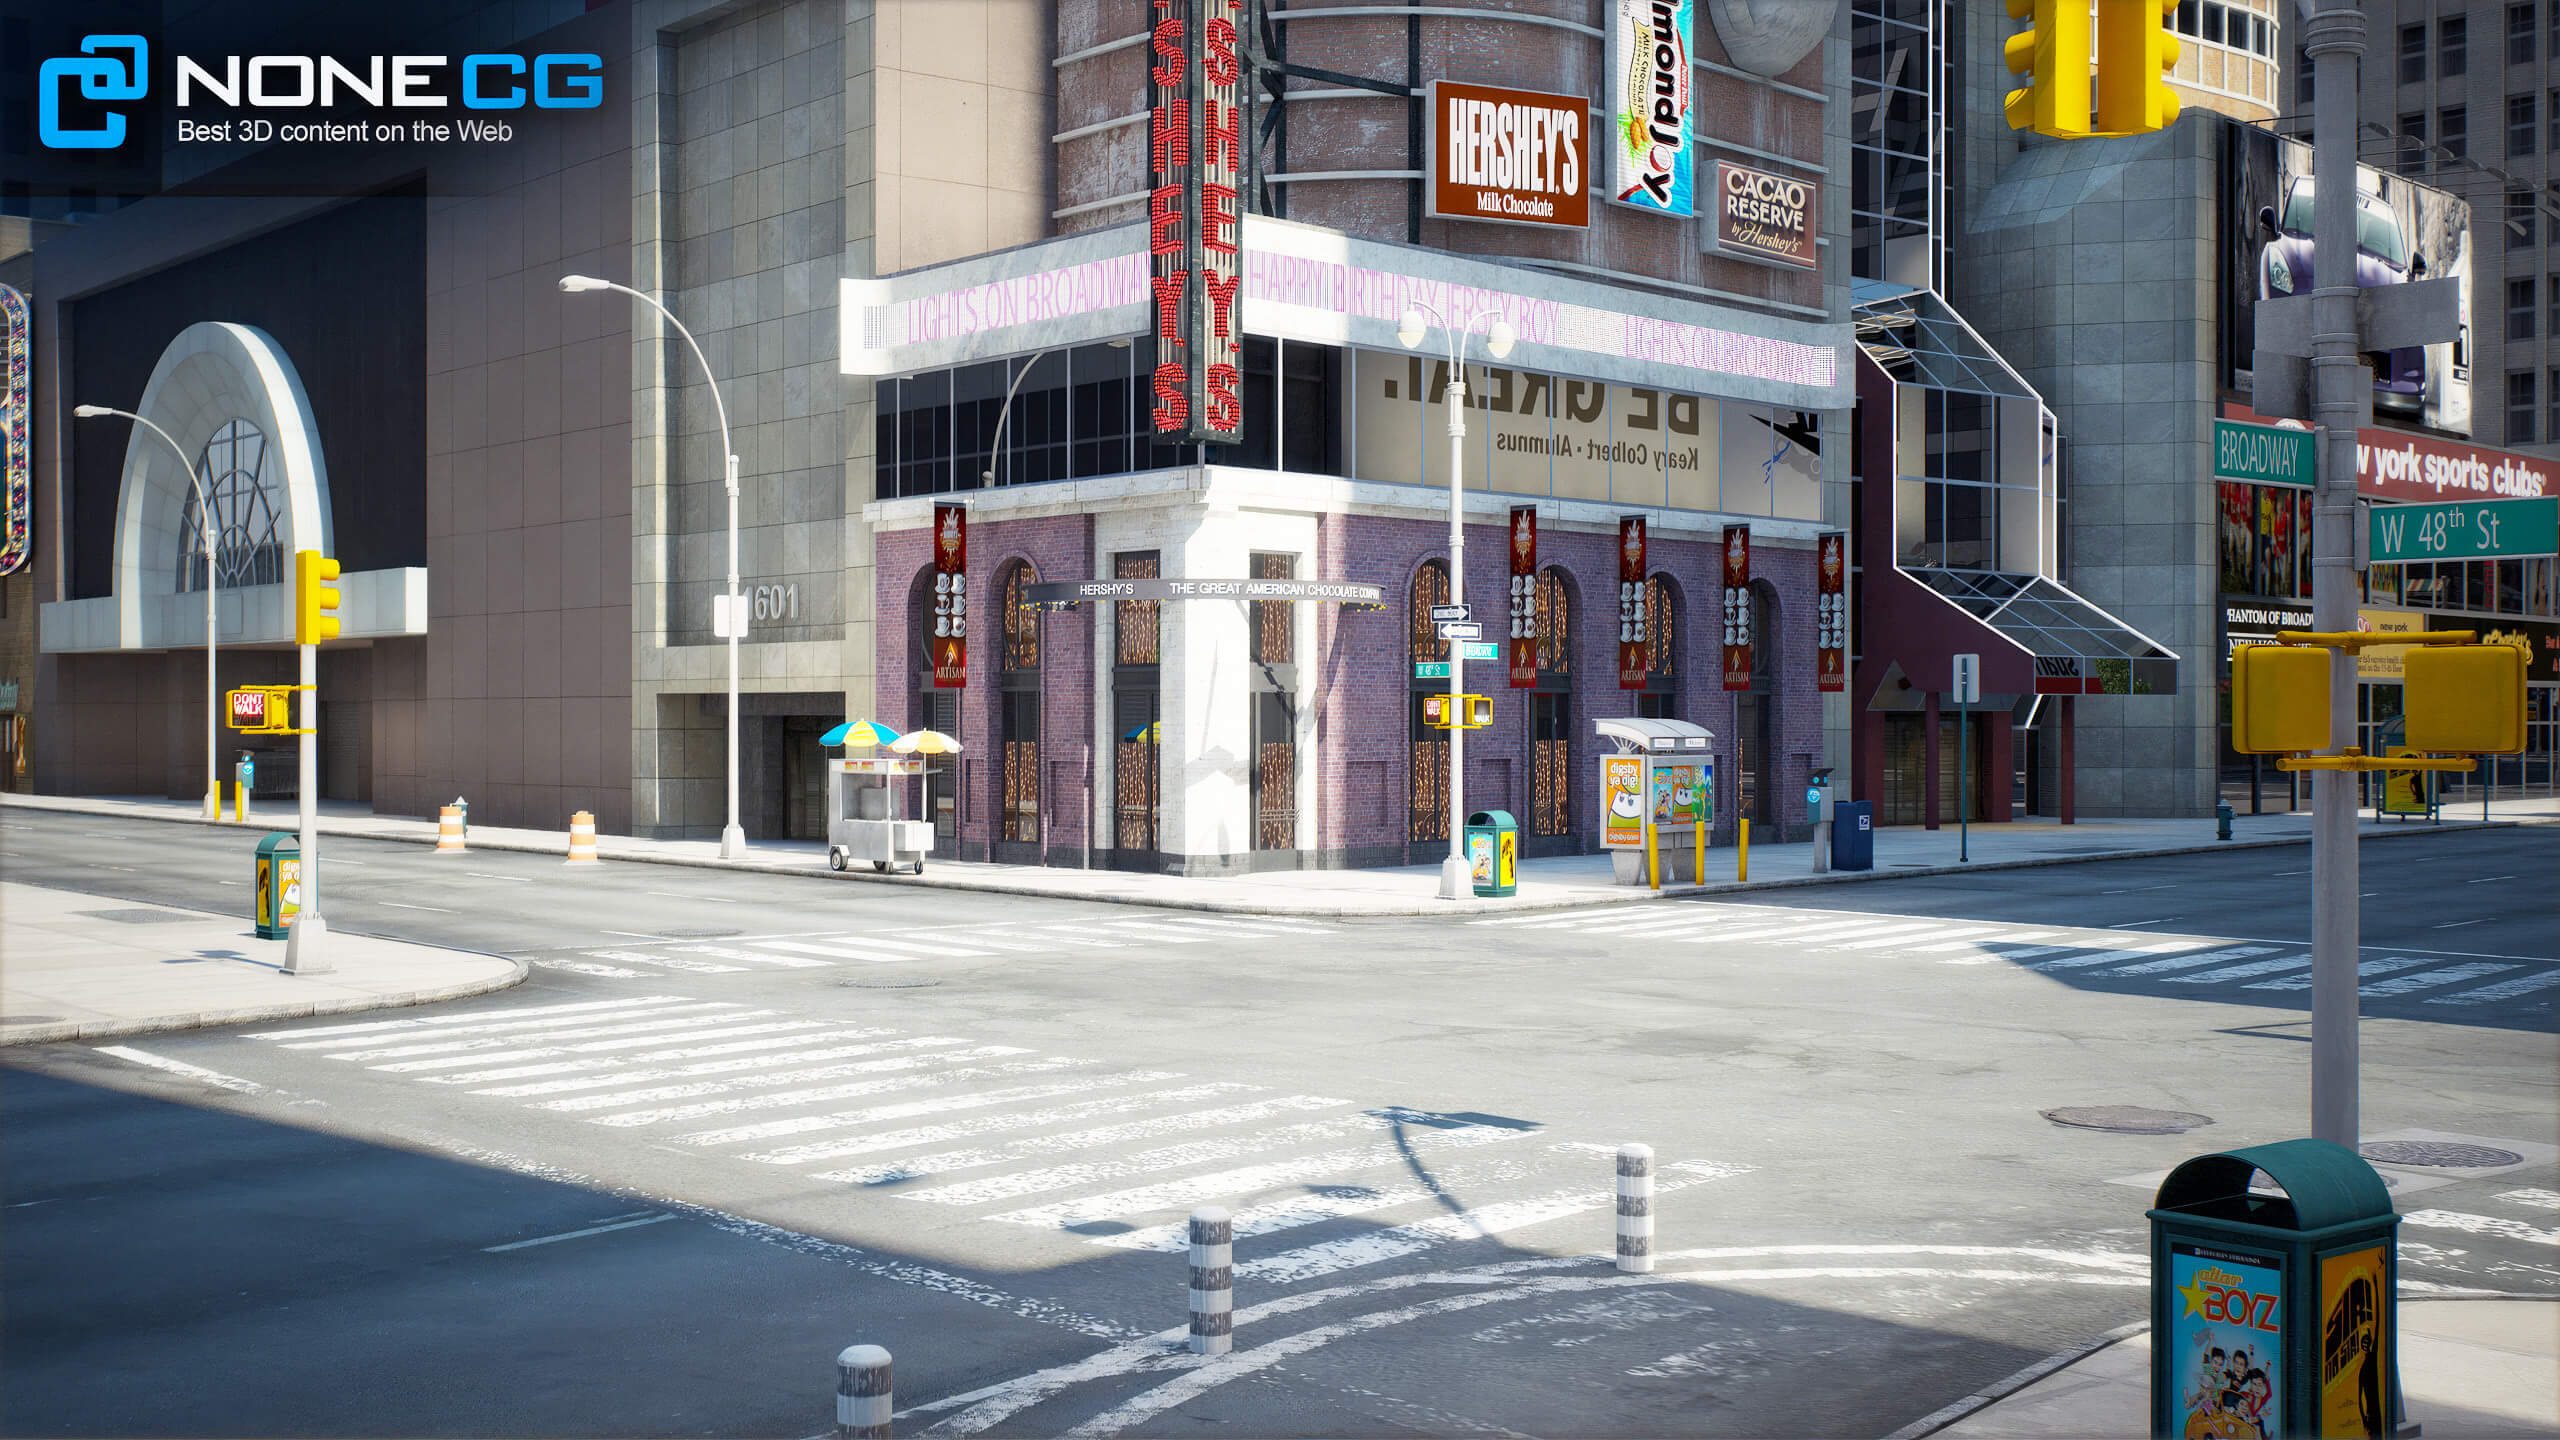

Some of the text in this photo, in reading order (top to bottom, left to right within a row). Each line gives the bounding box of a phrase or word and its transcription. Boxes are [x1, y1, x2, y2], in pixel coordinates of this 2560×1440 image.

[1449, 97, 1579, 196] HERSHEY'S
[1477, 191, 1554, 217] Milk Chocolate
[1726, 169, 1806, 209] CACAO
[1727, 194, 1804, 232] RESERVE
[1731, 221, 1799, 254] by Hershey's
[908, 286, 977, 345] LIGHTS
[984, 275, 1018, 329] ON
[1249, 249, 1329, 310] HAPPY
[1333, 264, 1439, 328] BIRTHDAY
[1520, 295, 1559, 346] BOY
[2221, 430, 2299, 477] BROADWAY
[2374, 443, 2422, 485] york
[2425, 454, 2489, 493] sports
[2493, 458, 2543, 497] clubs
[2381, 506, 2500, 553] W 48th St
[1080, 583, 1134, 596] HERSHY'S
[1169, 582, 1195, 594] THE
[1199, 583, 1241, 594] GREAT
[1246, 583, 1305, 596] AMERICAN
[1308, 584, 1358, 598] CHOCOLATE
[2268, 611, 2281, 624] OF
[935, 667, 965, 679] ARTISAN
[234, 703, 264, 715] WALK
[1610, 762, 1638, 776] digsby
[2203, 1283, 2280, 1333] BOYZ
